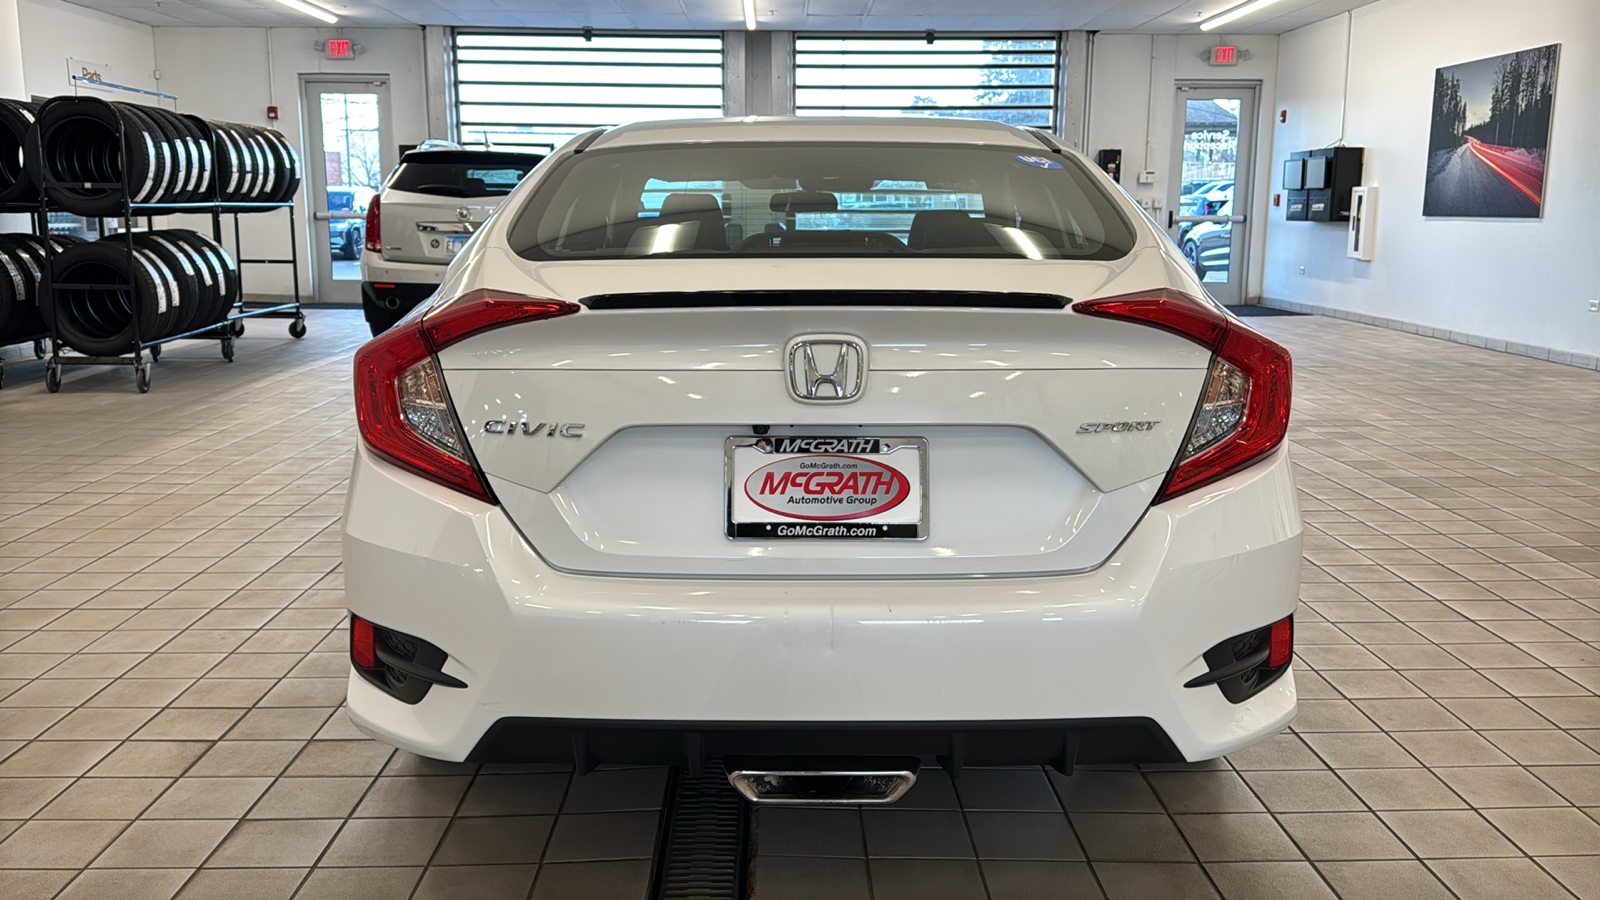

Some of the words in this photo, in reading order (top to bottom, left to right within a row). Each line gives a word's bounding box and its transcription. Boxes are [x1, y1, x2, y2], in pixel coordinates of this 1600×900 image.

[329, 39, 350, 56] EXIT
[1215, 46, 1235, 63] EXIT
[82, 67, 102, 82] Parts
[484, 420, 586, 438] CIVIC
[1075, 419, 1161, 434] SPORT
[799, 462, 858, 470] GoMcGrath.com
[787, 495, 843, 505] Automotive
[846, 495, 877, 506] Group
[777, 525, 876, 536] GoMcGrath.com
